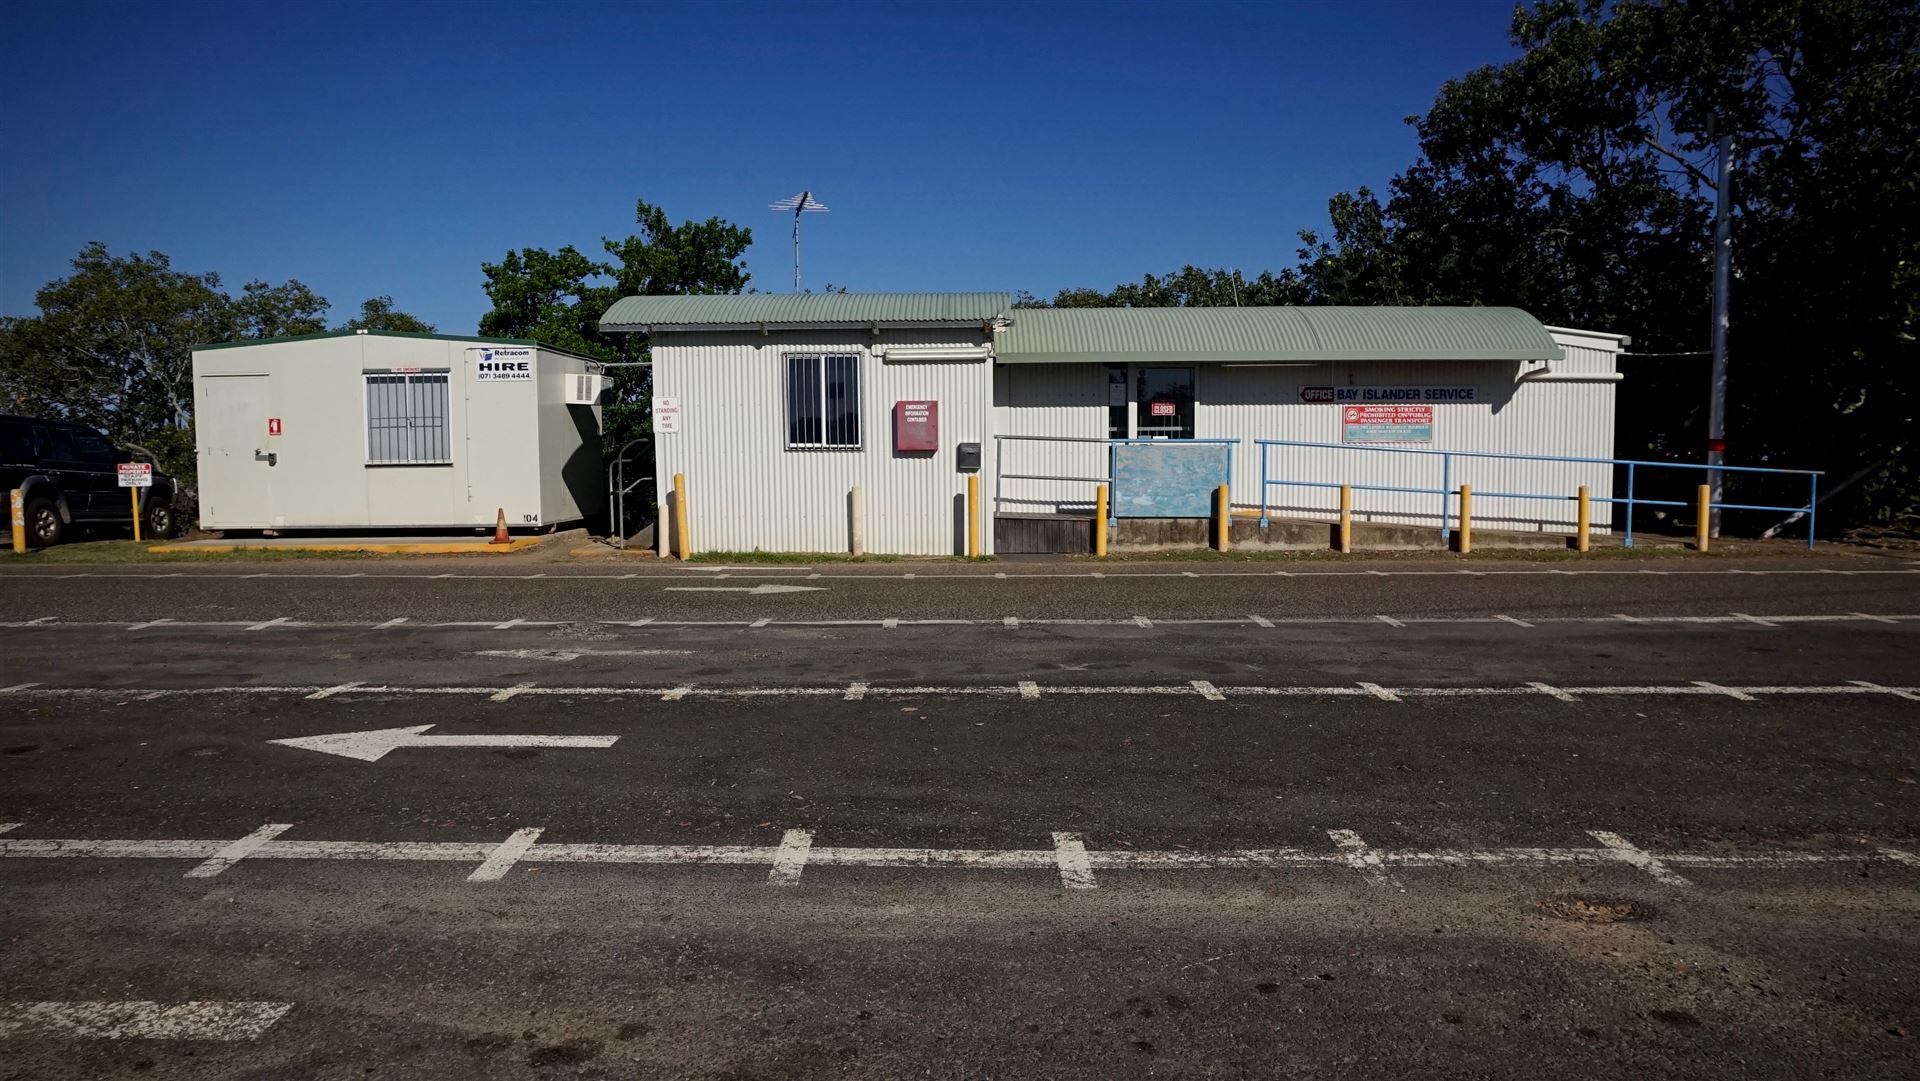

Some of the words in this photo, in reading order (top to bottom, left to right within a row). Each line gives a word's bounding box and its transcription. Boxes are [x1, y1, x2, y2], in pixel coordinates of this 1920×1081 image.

[1304, 390, 1333, 400] OFFICE
[1337, 388, 1358, 400] BAY
[1362, 388, 1420, 400] ISLANDER
[1424, 388, 1474, 400] SERVICE
[1154, 405, 1174, 414] CLOSED
